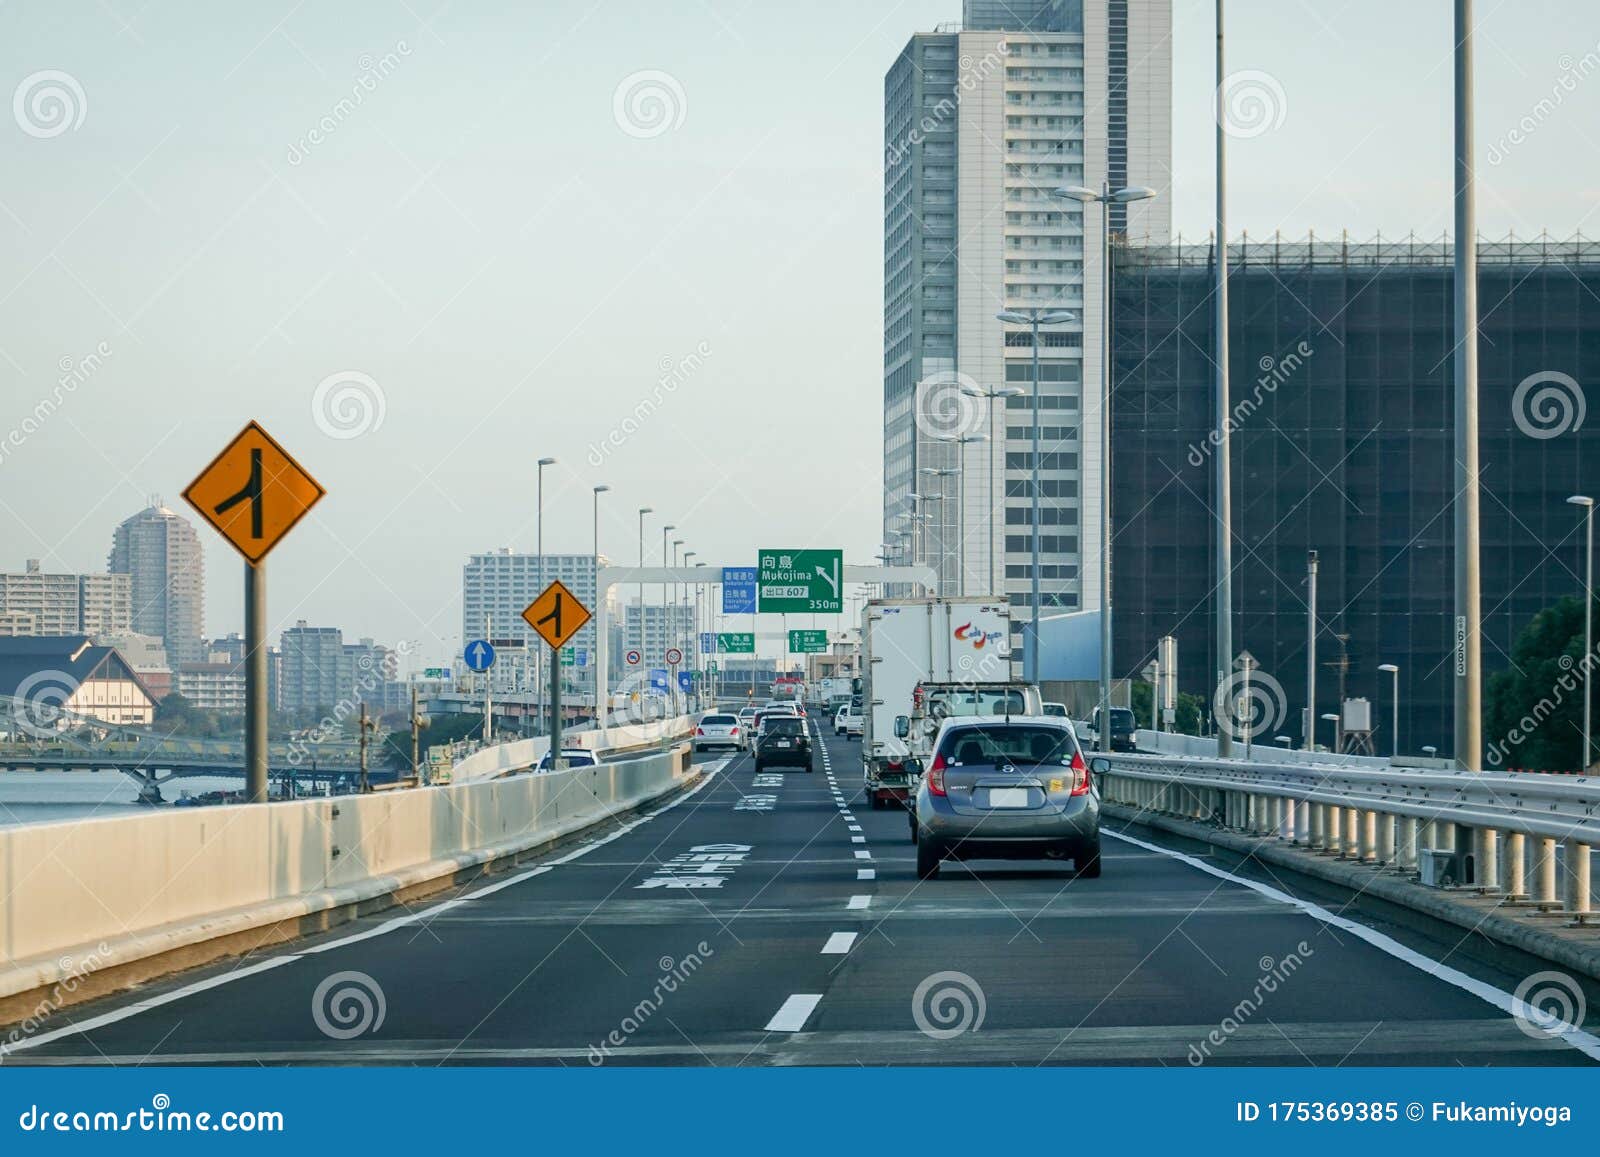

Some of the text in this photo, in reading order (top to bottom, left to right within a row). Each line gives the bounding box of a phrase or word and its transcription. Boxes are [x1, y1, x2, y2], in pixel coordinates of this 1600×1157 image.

[762, 555, 792, 569] 向島
[762, 570, 812, 582] Mukojima
[786, 588, 805, 596] 607
[809, 600, 839, 609] 350m
[1457, 630, 1465, 674] 6283
